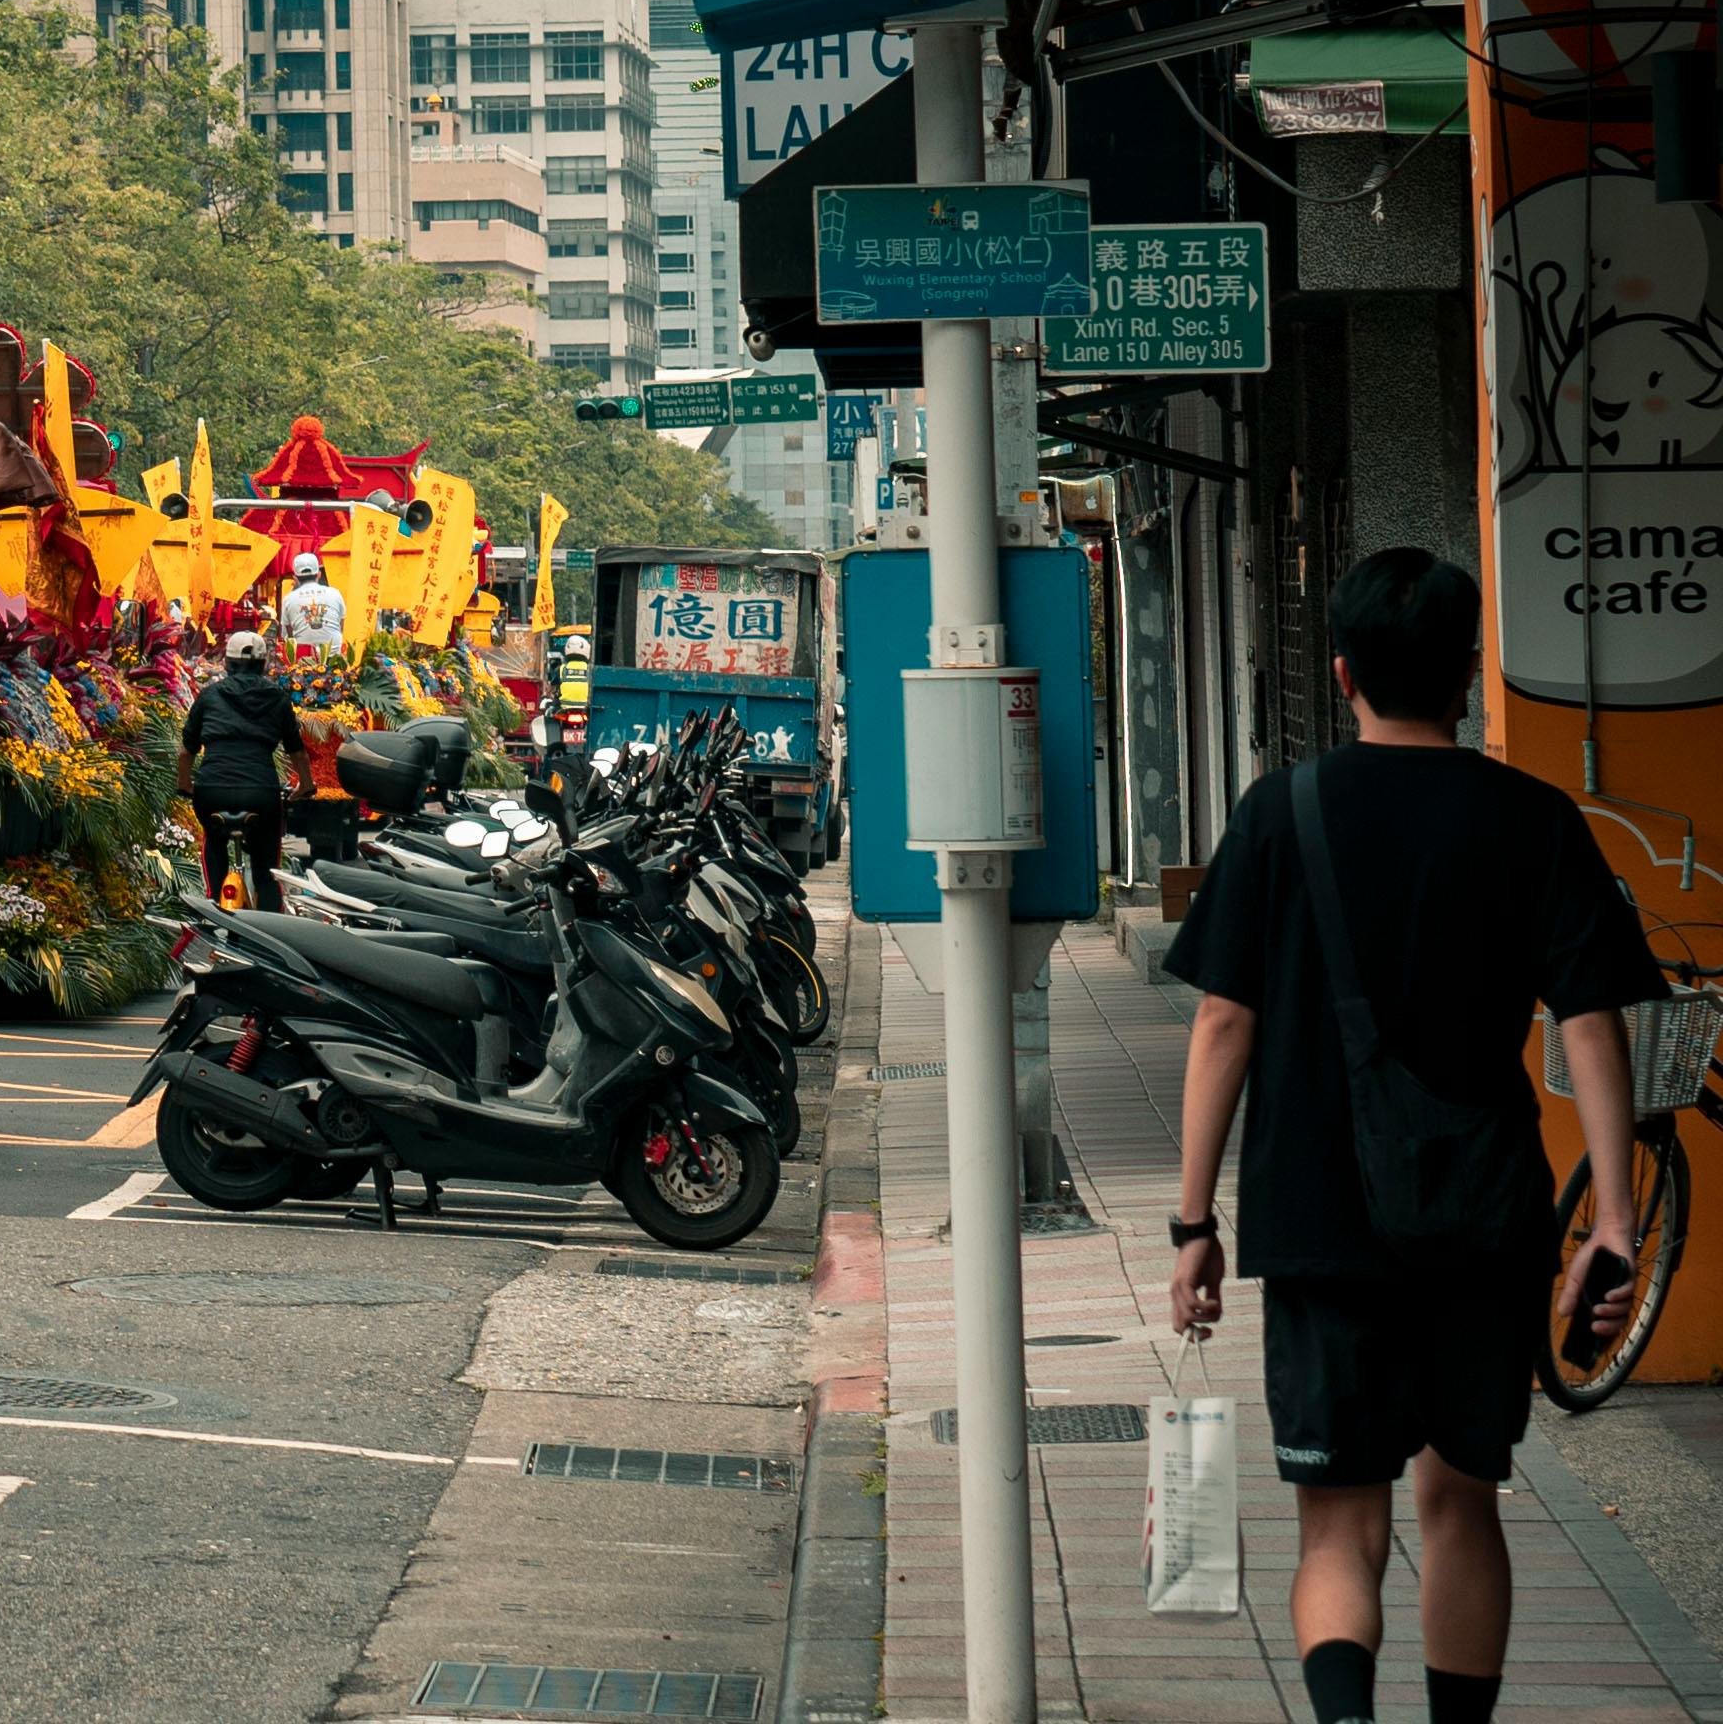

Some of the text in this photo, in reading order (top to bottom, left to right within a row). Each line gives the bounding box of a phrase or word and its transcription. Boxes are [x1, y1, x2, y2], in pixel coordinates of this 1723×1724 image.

[745, 32, 849, 81] 24H
[1269, 110, 1381, 132] 23782277
[854, 235, 1053, 270] 吳興國小(松仁)
[863, 271, 1047, 288] Wuxing Elementary School
[921, 287, 989, 301] (Songren)
[1074, 315, 1229, 339] XinYi Rd. Sec. 5
[1062, 339, 1243, 366] Lane 150 Alley 305
[1544, 524, 1723, 560] cama
[1563, 561, 1708, 616] café
[649, 592, 785, 642] 億圓
[1011, 687, 1033, 709] 33
